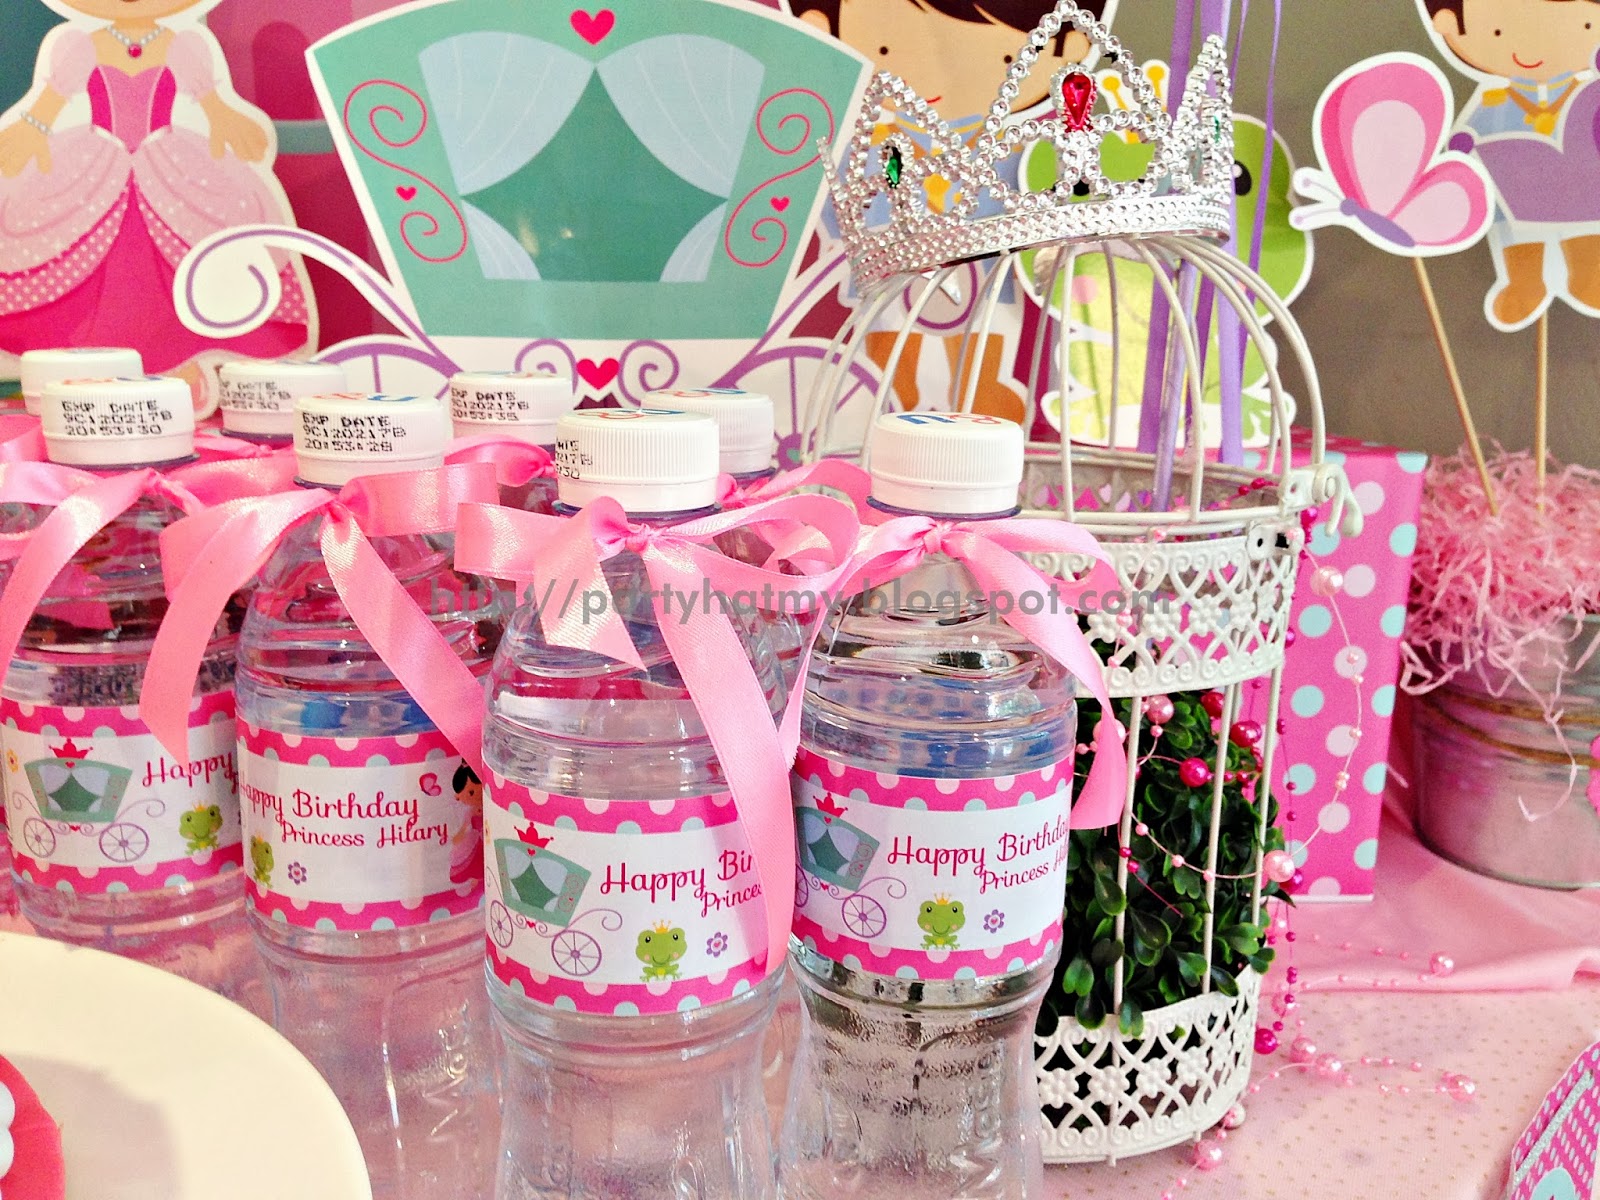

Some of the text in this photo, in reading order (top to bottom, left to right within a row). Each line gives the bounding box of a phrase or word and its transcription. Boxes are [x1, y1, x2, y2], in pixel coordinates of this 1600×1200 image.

[109, 400, 158, 413] DATE
[475, 391, 516, 401] DATE
[302, 412, 391, 427] EXP DATE
[142, 751, 233, 789] Happy
[292, 788, 420, 826] Birthday
[281, 819, 448, 848] Princess Hilary
[887, 835, 985, 877] Happy
[600, 862, 707, 904] Happy
[980, 862, 1049, 894] Princess
